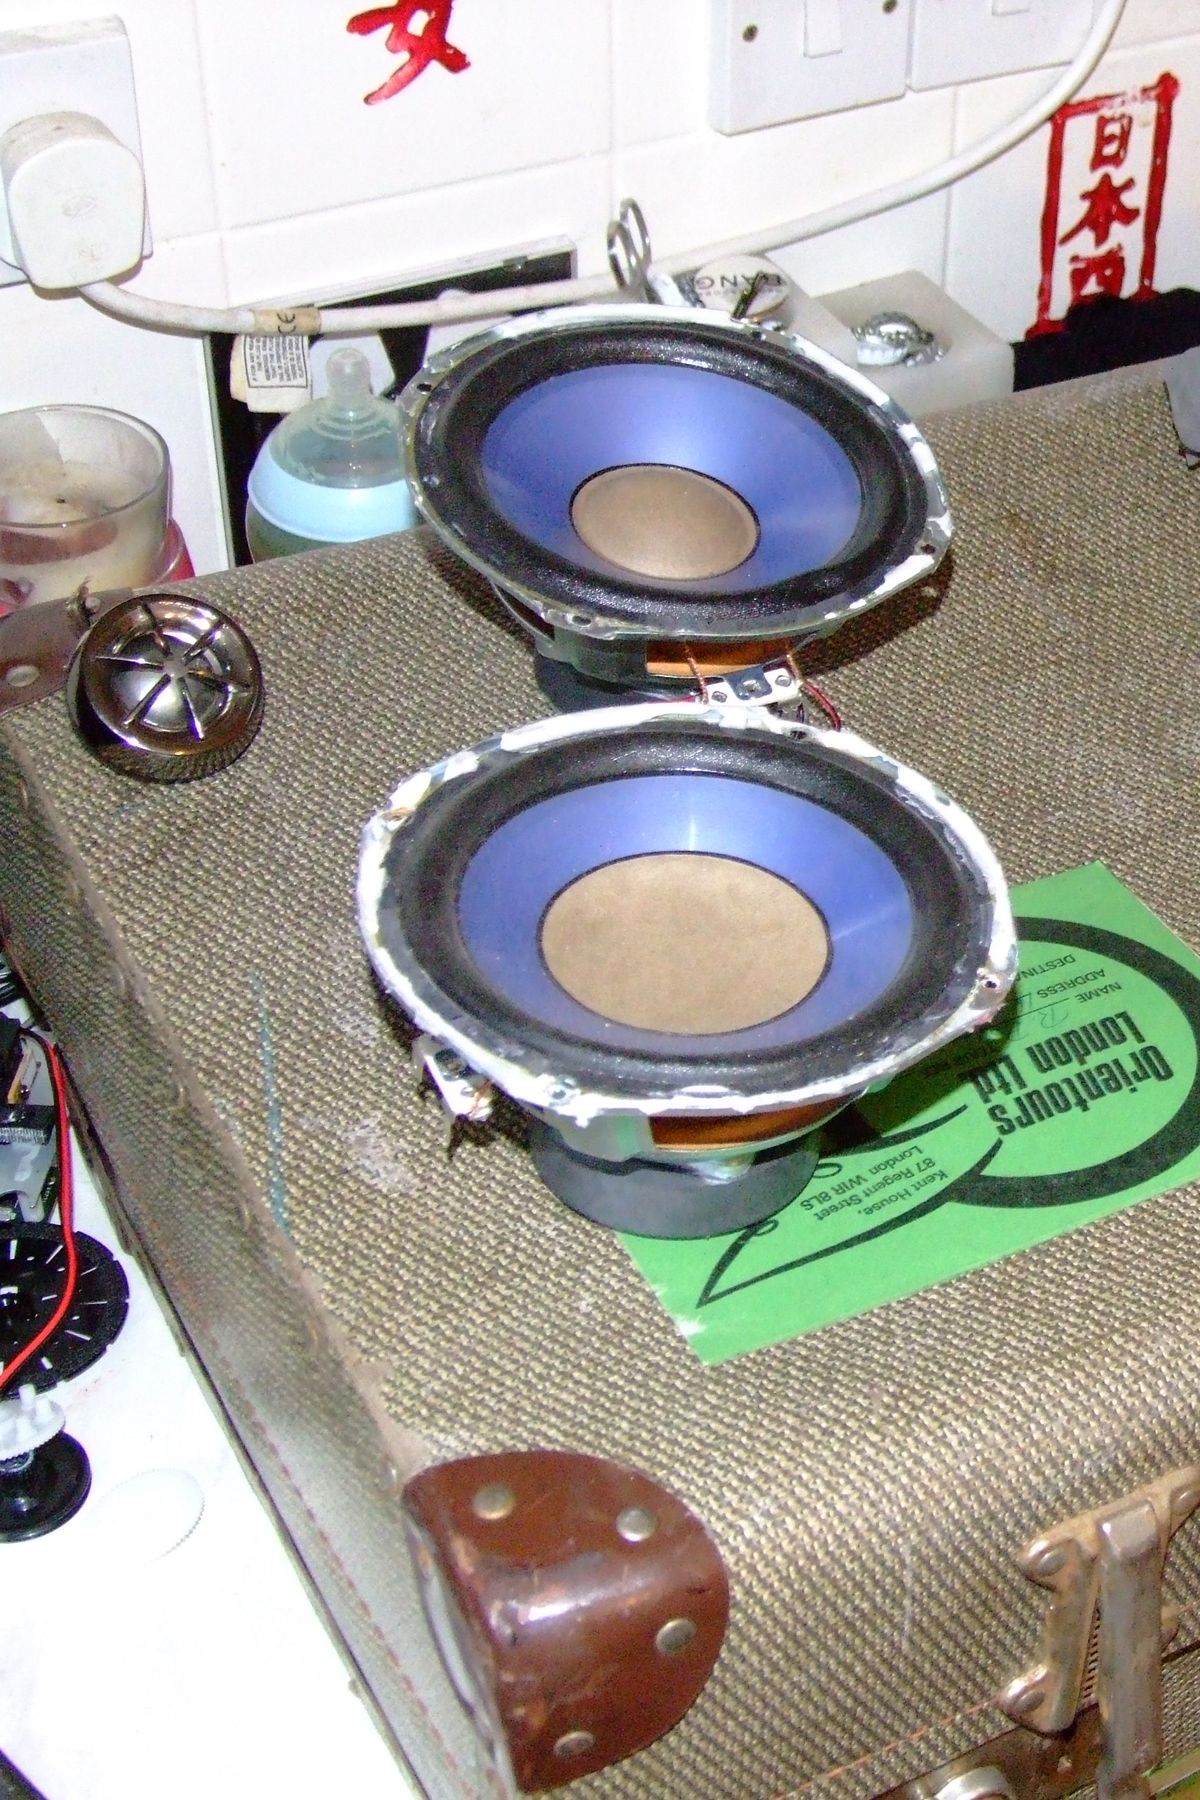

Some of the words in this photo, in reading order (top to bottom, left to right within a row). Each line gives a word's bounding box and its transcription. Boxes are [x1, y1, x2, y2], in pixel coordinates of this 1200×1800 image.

[1037, 968, 1106, 998] ADDRESS
[1074, 982, 1122, 1003] NAME
[1025, 1010, 1146, 1074] London
[987, 1045, 1174, 1136] Orientours
[868, 1145, 923, 1174] London
[916, 1157, 936, 1173] 87
[862, 1167, 915, 1197] Regent
[911, 1169, 948, 1191] Kent
[800, 1191, 832, 1211] 8LS
[813, 1194, 862, 1221] Street
